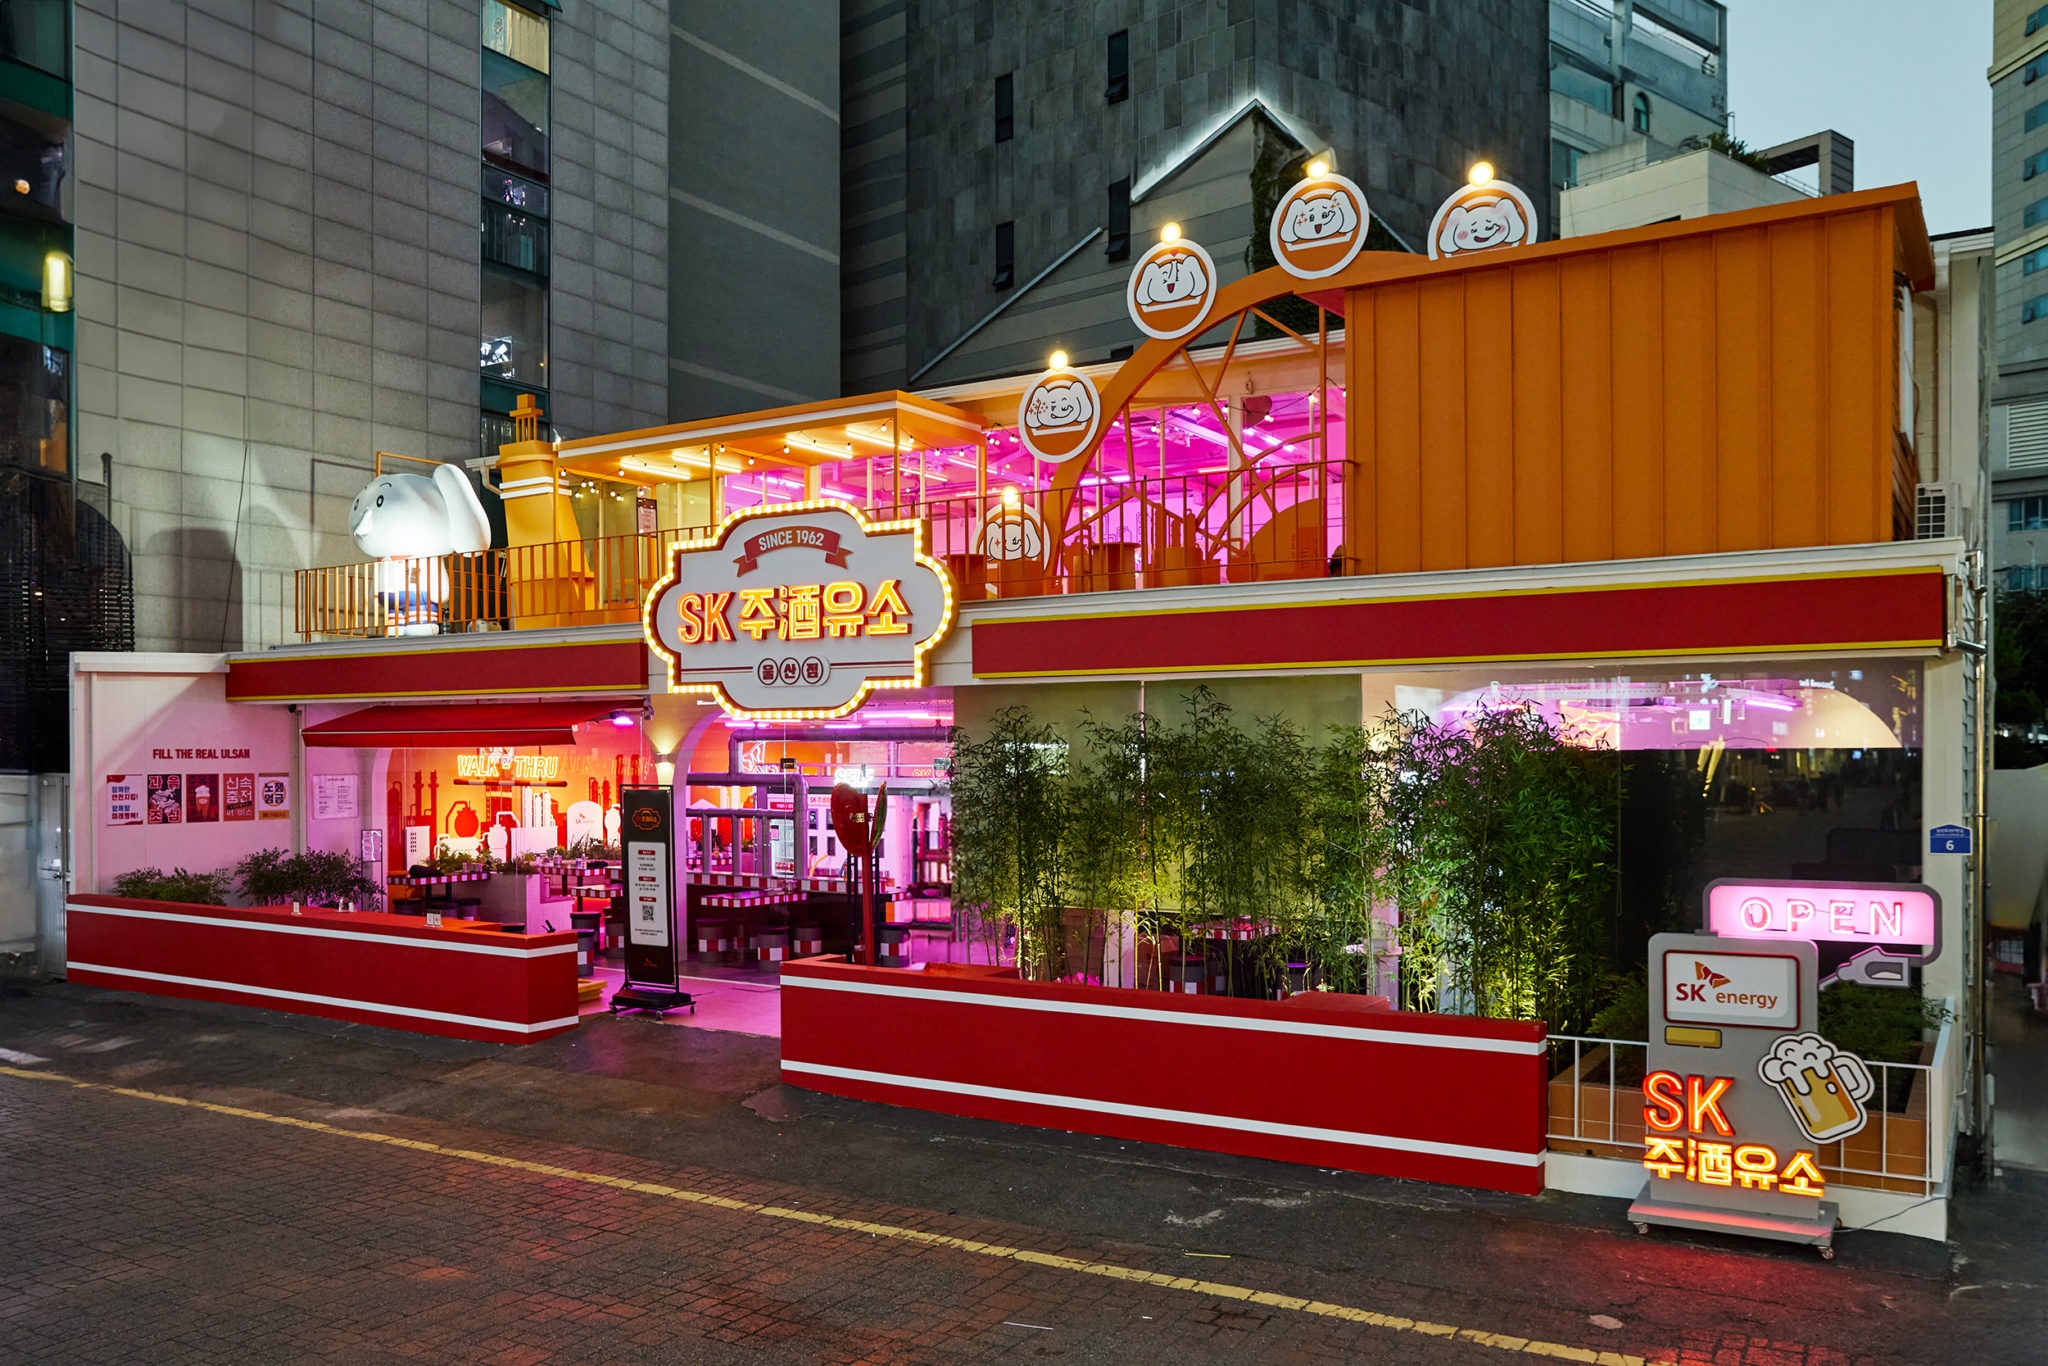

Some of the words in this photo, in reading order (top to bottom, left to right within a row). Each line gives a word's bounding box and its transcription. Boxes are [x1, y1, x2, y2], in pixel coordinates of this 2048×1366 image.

[758, 532, 793, 551] SINCE
[796, 530, 825, 547] 1962
[677, 591, 737, 644] SK
[738, 579, 912, 641] 주酒유소
[759, 660, 822, 683] 울산점
[152, 748, 174, 760] FILL
[175, 748, 194, 760] THE
[195, 748, 219, 760] REAL
[220, 748, 250, 760] ULSAN
[226, 777, 252, 790] 신속
[834, 768, 875, 788] SELF
[226, 790, 252, 804] 충전
[1945, 840, 1955, 851] 6
[1739, 896, 1904, 937] OPEN
[1675, 982, 1707, 1003] SK
[1715, 989, 1779, 1010] energy
[1642, 1069, 1736, 1137] SK
[1642, 1134, 1826, 1199] 주酒유소
